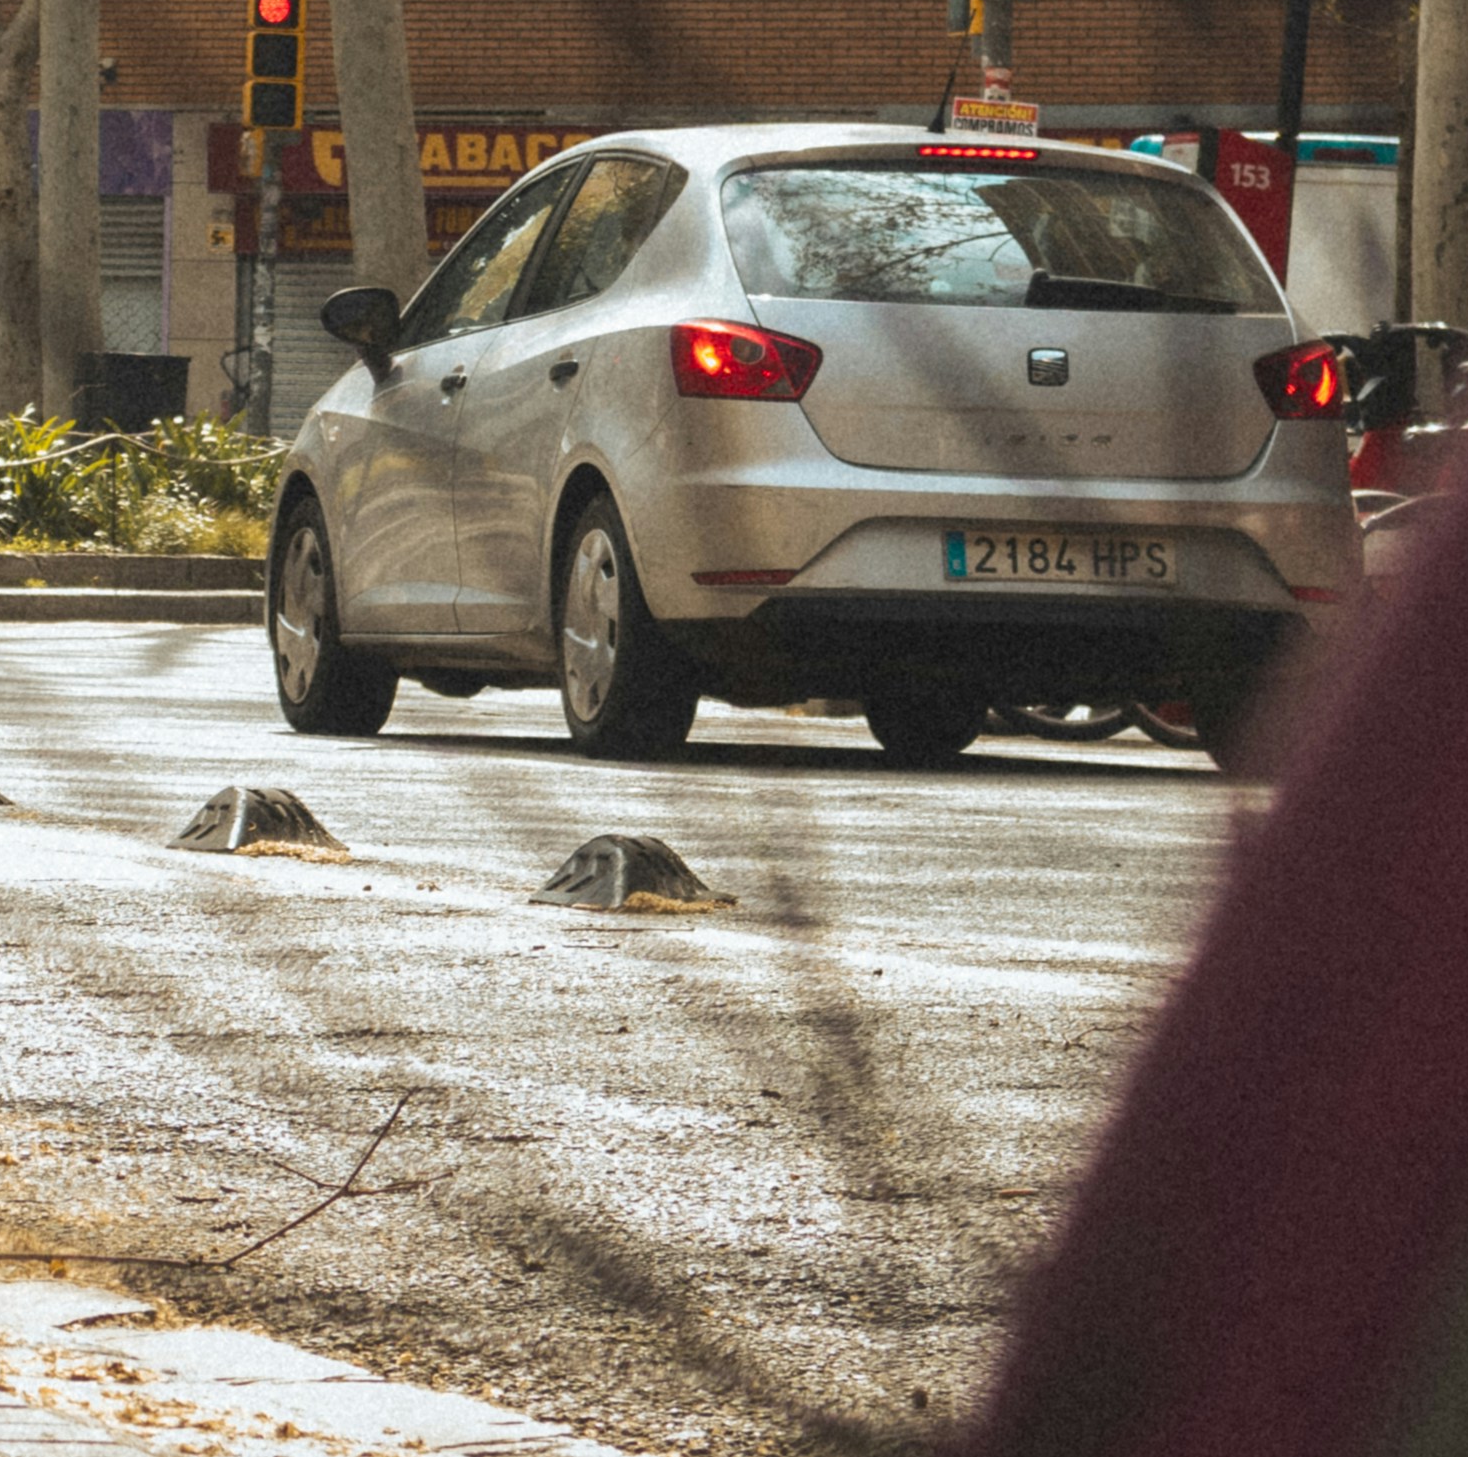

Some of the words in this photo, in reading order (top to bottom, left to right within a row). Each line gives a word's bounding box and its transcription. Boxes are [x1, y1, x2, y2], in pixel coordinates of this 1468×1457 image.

[954, 117, 1034, 136] COMPRAMOS
[416, 132, 592, 172] ABAC
[1230, 163, 1271, 191] 153
[974, 536, 1076, 575] 2184
[1093, 539, 1167, 578] HPS
